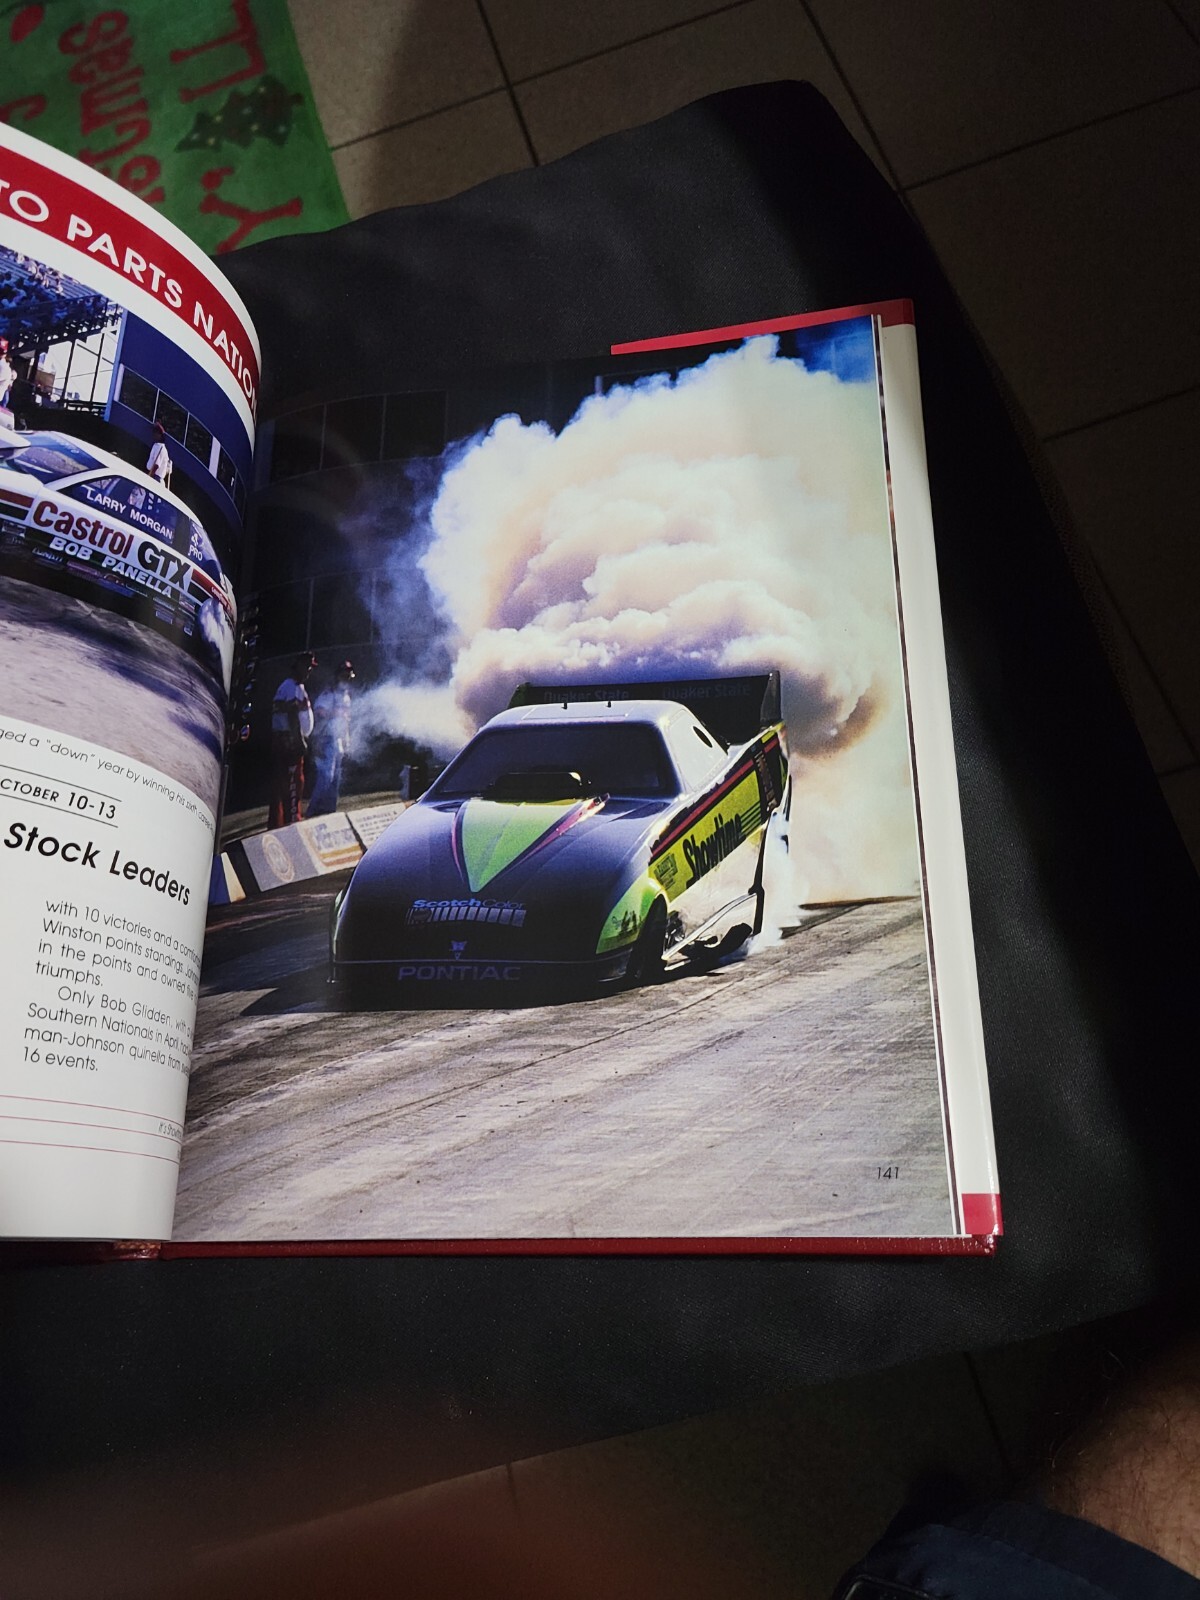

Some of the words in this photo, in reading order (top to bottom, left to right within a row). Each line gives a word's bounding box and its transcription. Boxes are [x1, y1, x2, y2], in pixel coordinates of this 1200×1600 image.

[66, 213, 183, 308] PARTS
[86, 487, 127, 515] LARRY
[130, 508, 174, 540] MORGAN
[33, 500, 135, 559] Castrol
[137, 541, 191, 592] GTX
[49, 537, 94, 561] BOB
[102, 556, 173, 599] PANELLA
[188, 545, 203, 561] PRO
[29, 737, 40, 747] a
[97, 758, 125, 775] year
[126, 768, 141, 782] by
[142, 776, 175, 801] winning
[175, 792, 185, 806] his
[68, 791, 117, 819] 10-13
[3, 822, 101, 869] Stock
[109, 849, 191, 906] Leaders
[682, 813, 744, 890] Showtime
[43, 917, 102, 944] Winston
[105, 936, 143, 956] points
[46, 900, 78, 918] with
[85, 905, 100, 923] 10
[103, 913, 151, 939] victories
[153, 931, 172, 947] and
[173, 940, 179, 951] a
[35, 960, 104, 986] triumphs.
[38, 938, 53, 956] in
[61, 943, 86, 961] the
[92, 953, 132, 974] points
[136, 965, 158, 981] and
[161, 974, 186, 994] owned
[398, 965, 522, 982] PONTIAC
[27, 1002, 98, 1028] Southern
[101, 1014, 154, 1041] Nationals
[155, 1029, 163, 1043] in
[58, 985, 96, 1009] Only
[100, 993, 128, 1013] Bob
[132, 1002, 173, 1028] Glidden,
[175, 1018, 186, 1033] with
[24, 1027, 125, 1055] man-Johnson
[129, 1045, 166, 1065] quinella
[168, 1053, 181, 1071] from
[24, 1046, 41, 1063] 16
[45, 1052, 98, 1071] events.
[876, 1166, 900, 1180] 141
